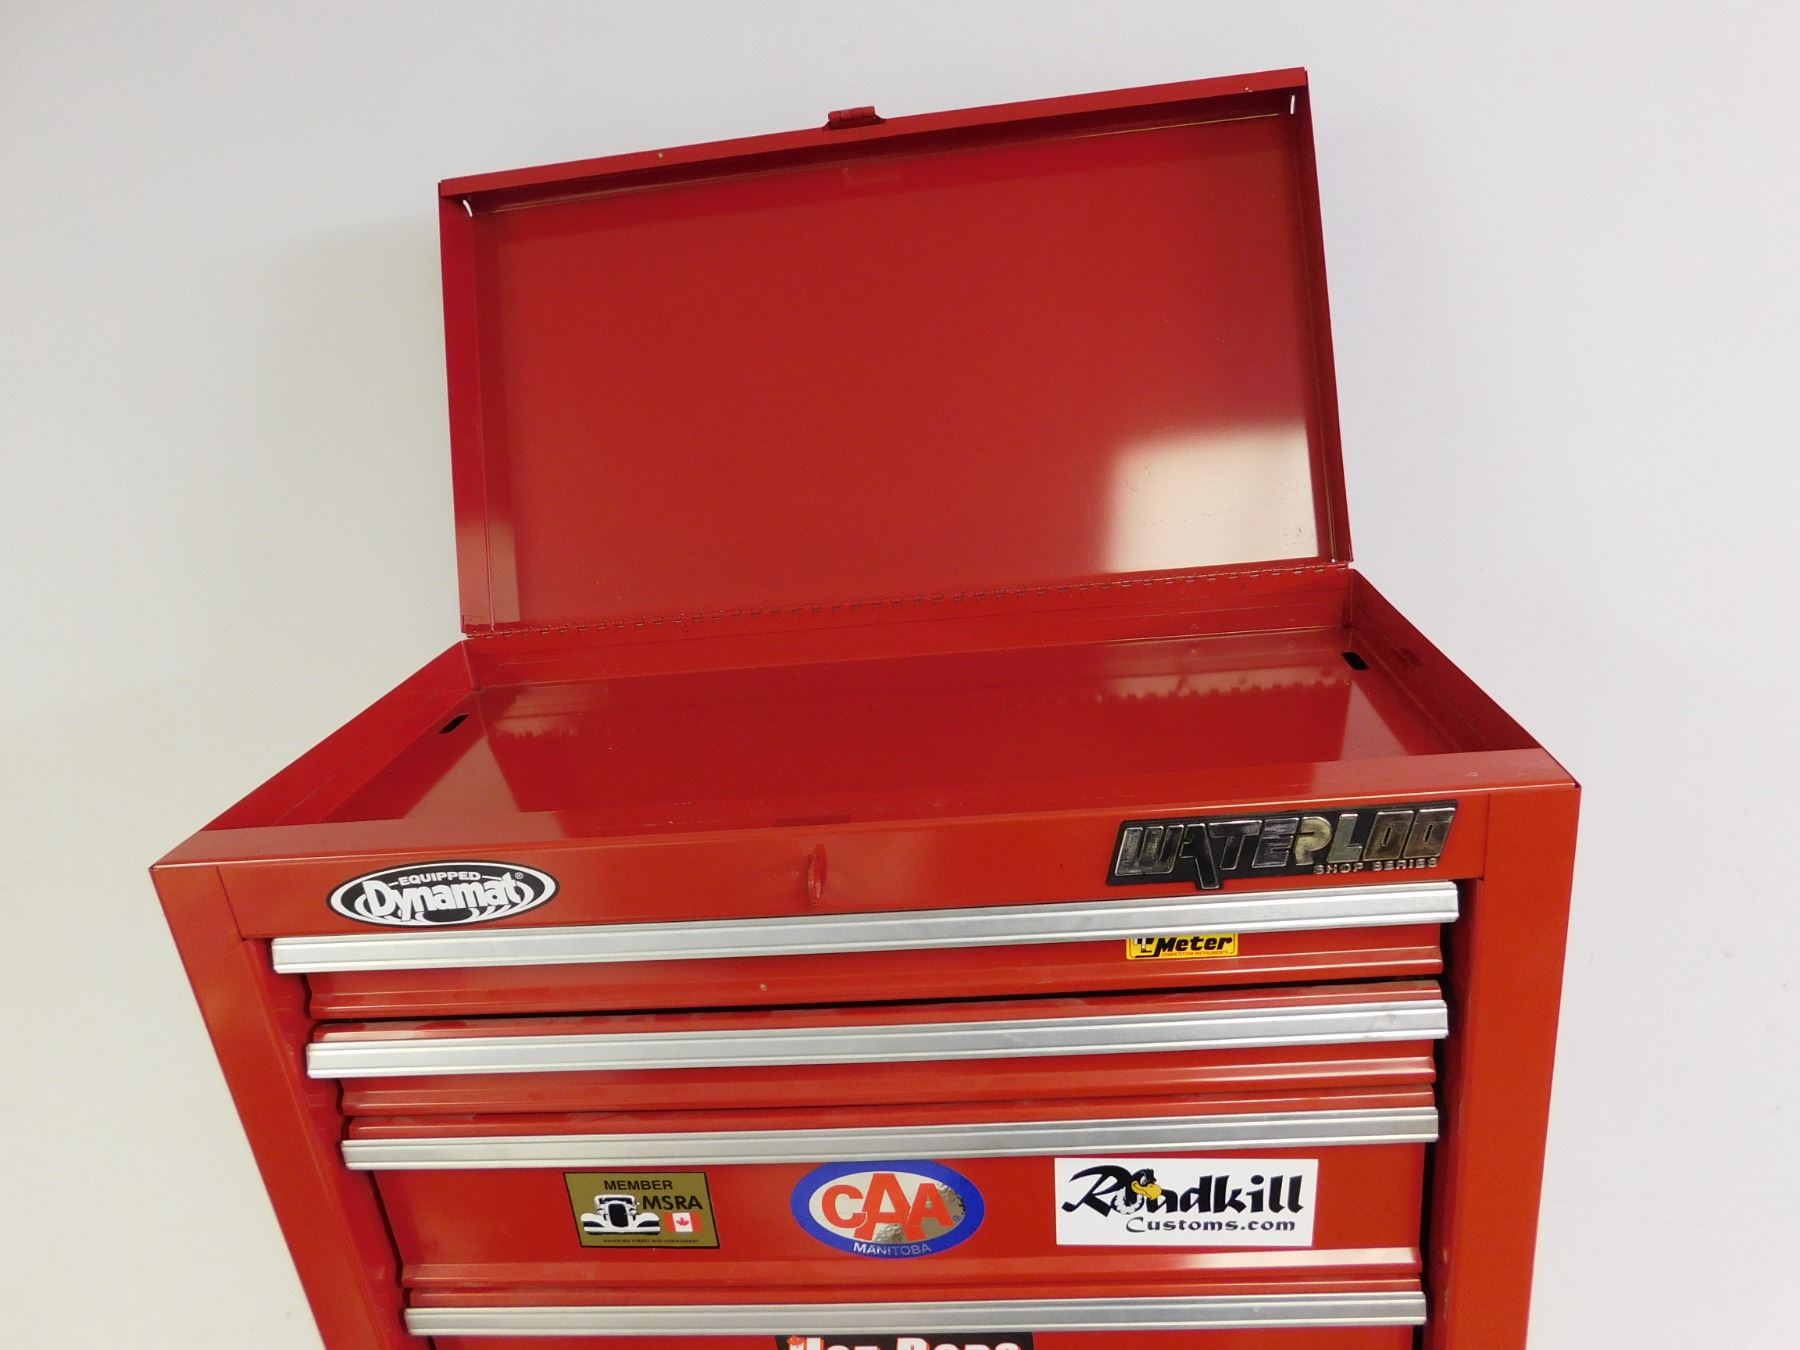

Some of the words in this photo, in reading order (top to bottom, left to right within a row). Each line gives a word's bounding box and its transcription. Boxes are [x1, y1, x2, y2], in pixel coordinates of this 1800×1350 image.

[1114, 807, 1456, 889] WATERLOO
[1313, 861, 1364, 875] SHOP
[1372, 857, 1438, 872] SERIES
[398, 871, 481, 886] EQUIPPED
[362, 872, 522, 922] Dynamat
[1155, 935, 1233, 955] Meter
[603, 1180, 674, 1191] MEMBER
[642, 1195, 704, 1211] MSRA
[821, 1172, 955, 1242] CAA
[1125, 1216, 1296, 1233] Customs.com
[853, 1241, 933, 1256] MANITOBA
